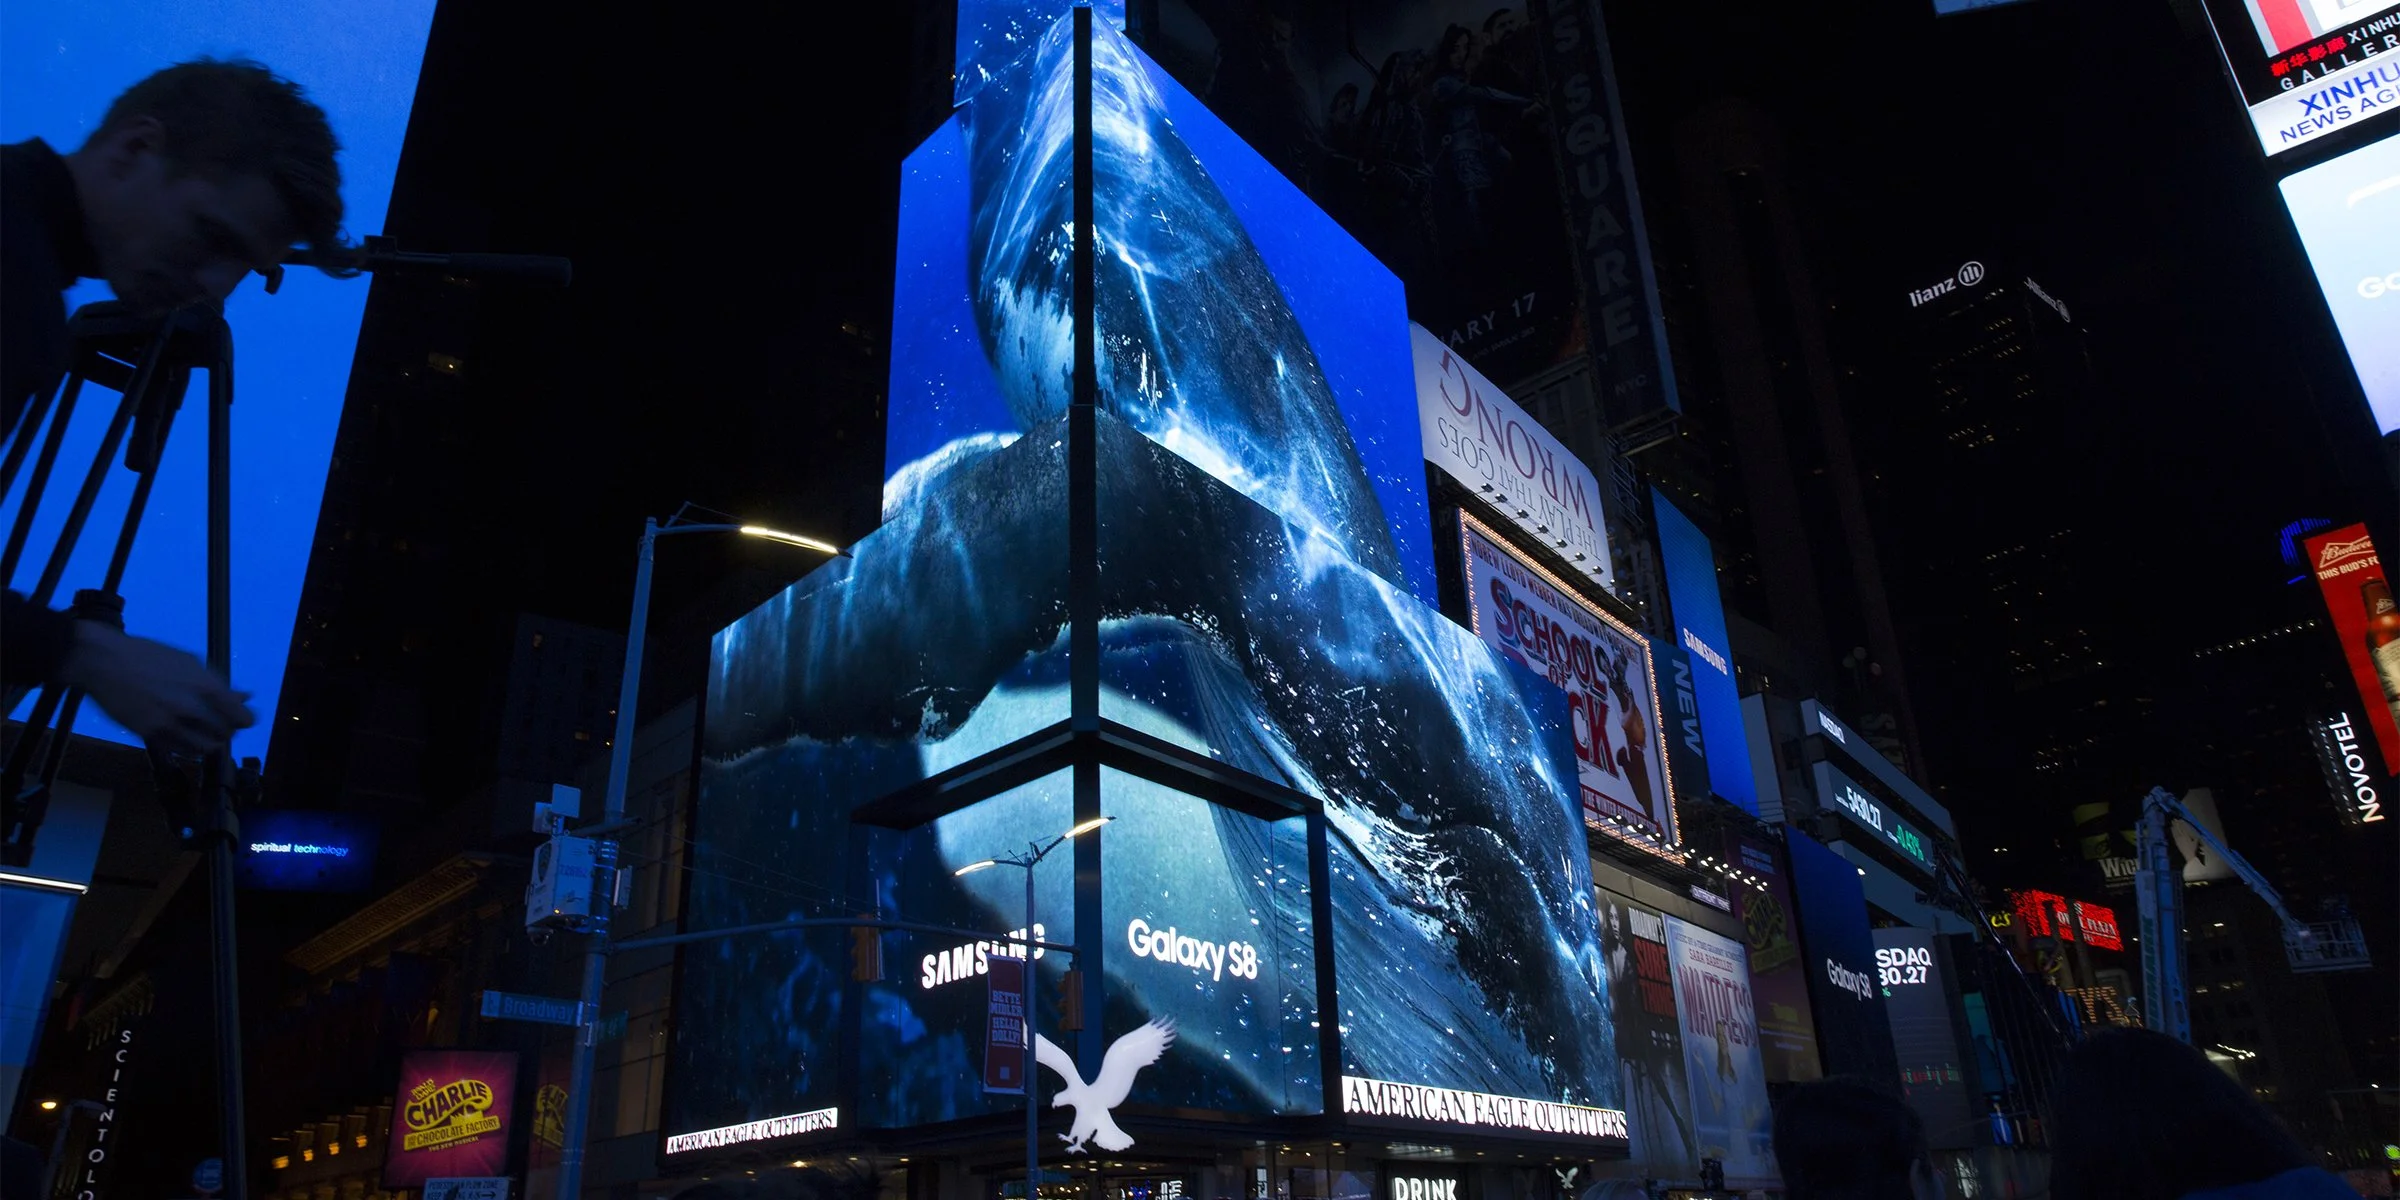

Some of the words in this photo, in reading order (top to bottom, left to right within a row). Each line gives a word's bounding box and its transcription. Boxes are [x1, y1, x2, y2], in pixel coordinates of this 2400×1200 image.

[2280, 105, 2352, 143] NEWS
[1563, 74, 1640, 349] SQUARE
[1440, 309, 1496, 348] ARY
[1511, 291, 1536, 318] 17
[1437, 416, 1495, 482] GOES
[1439, 350, 1596, 534] WRONG
[1499, 465, 1537, 511] THAT
[1538, 496, 1576, 546] PLAY
[1577, 524, 1602, 562] THE
[1490, 575, 1608, 701] SCHOOL
[1683, 627, 1728, 676] SAMSUNG
[1672, 658, 1703, 758] NEW
[2329, 711, 2385, 823] NOVOTEL
[250, 842, 291, 853] spiritual
[294, 844, 349, 857] technology
[1128, 918, 1226, 982] Galaxy
[1228, 941, 1257, 980] S8
[1827, 958, 1861, 1001] Galaxy
[1860, 971, 1872, 999] S8
[504, 996, 576, 1022] Broadway
[990, 1003, 1023, 1017] MIDLER
[407, 1081, 488, 1127] CHARLIE
[1350, 1079, 1468, 1124] AMERICAN
[1473, 1092, 1531, 1129] EAGLE
[1534, 1102, 1628, 1139] OUTFITTERS
[417, 1125, 464, 1145] CHOCOLATE
[466, 1118, 498, 1134] FACTORY
[669, 1129, 722, 1153] AMERICAN
[724, 1123, 758, 1144] EAGLE
[761, 1110, 832, 1139] OUTFITTERS
[1394, 1177, 1457, 1200] DRINK
